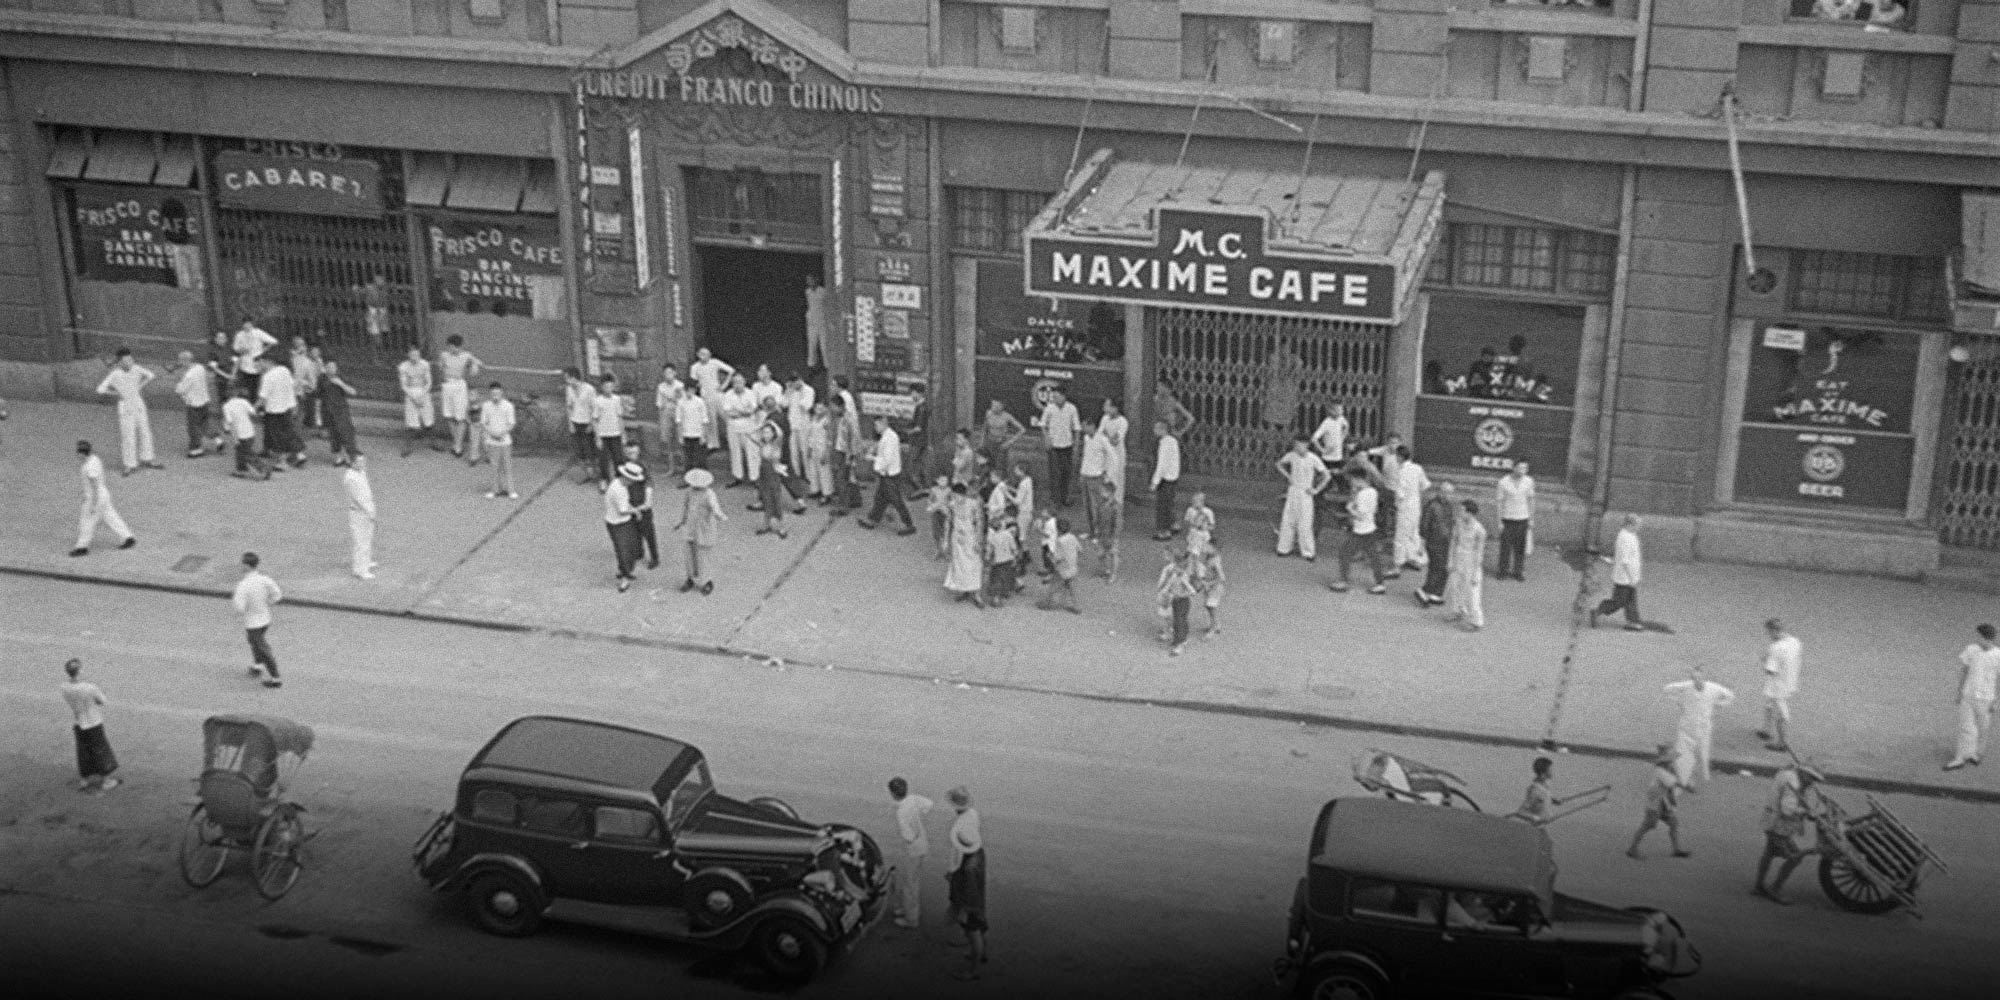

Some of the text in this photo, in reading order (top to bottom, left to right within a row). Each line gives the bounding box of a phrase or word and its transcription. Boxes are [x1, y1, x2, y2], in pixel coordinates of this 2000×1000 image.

[585, 71, 884, 112] CREDIT FRANCO CHINOIS
[77, 200, 140, 226] FRISCO
[121, 230, 152, 241] BAR
[431, 228, 563, 264] FRISCO CAFE
[478, 258, 512, 272] BAR
[1053, 252, 1370, 306] MAXIME CAFE
[1773, 398, 1888, 427] MAXIME
[1471, 455, 1514, 470] BEER
[1799, 482, 1843, 498] BEER
